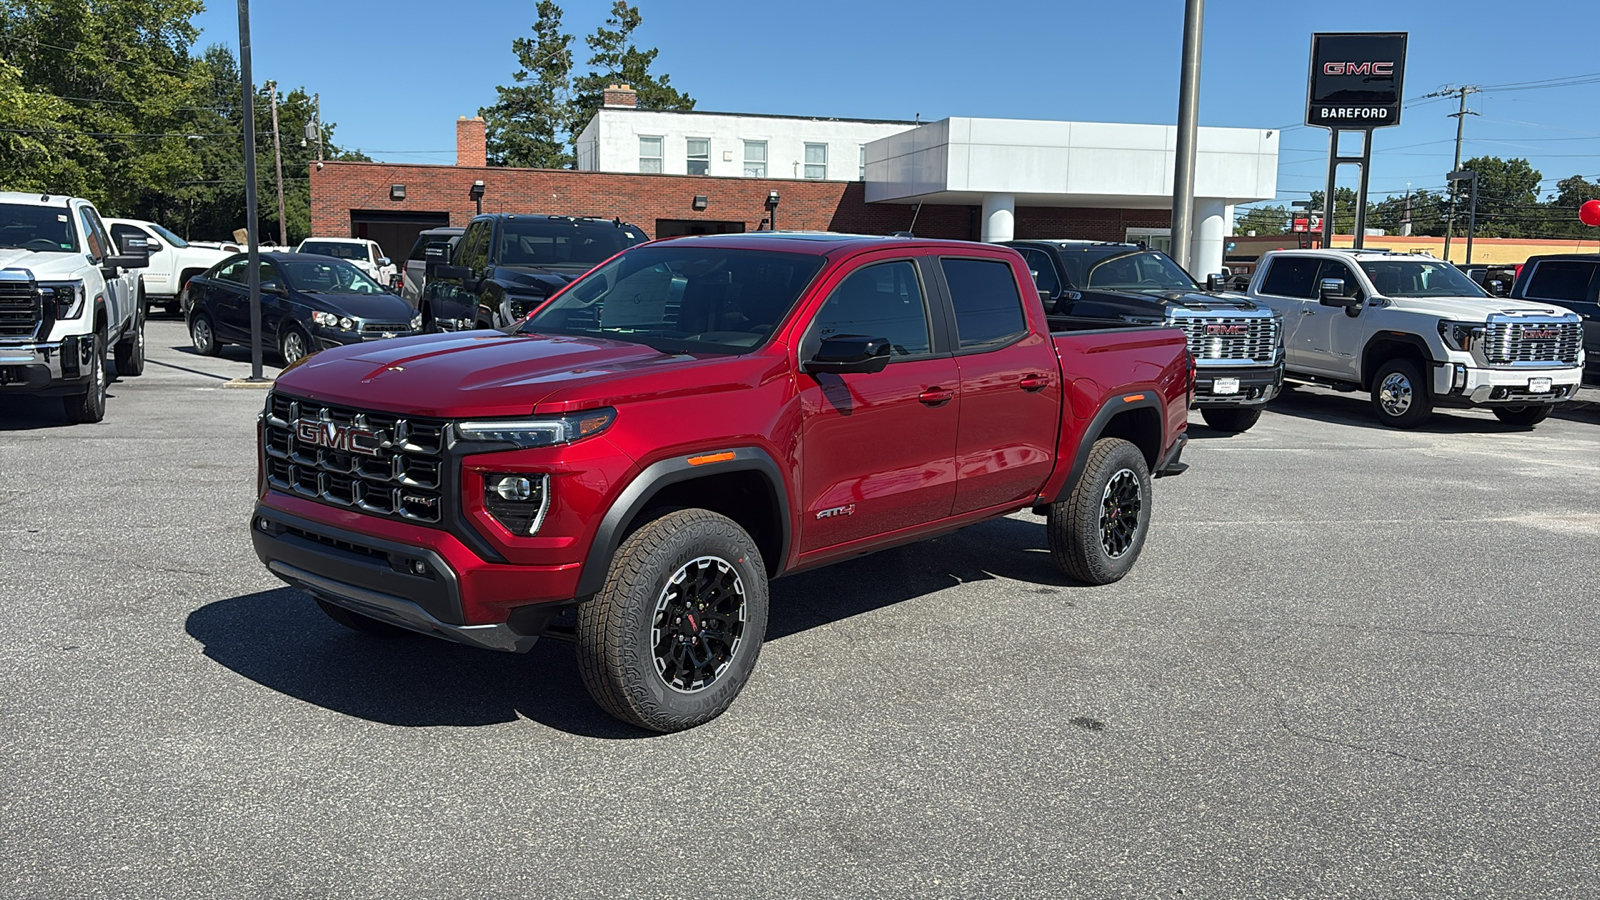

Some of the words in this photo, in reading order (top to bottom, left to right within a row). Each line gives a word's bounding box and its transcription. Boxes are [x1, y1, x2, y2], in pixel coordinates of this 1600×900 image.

[1323, 61, 1395, 75] GMC
[1321, 107, 1388, 118] BAREFORD
[1207, 324, 1248, 335] GMC
[1524, 330, 1560, 339] GMC
[297, 418, 379, 456] GMC
[815, 504, 856, 520] AT4
